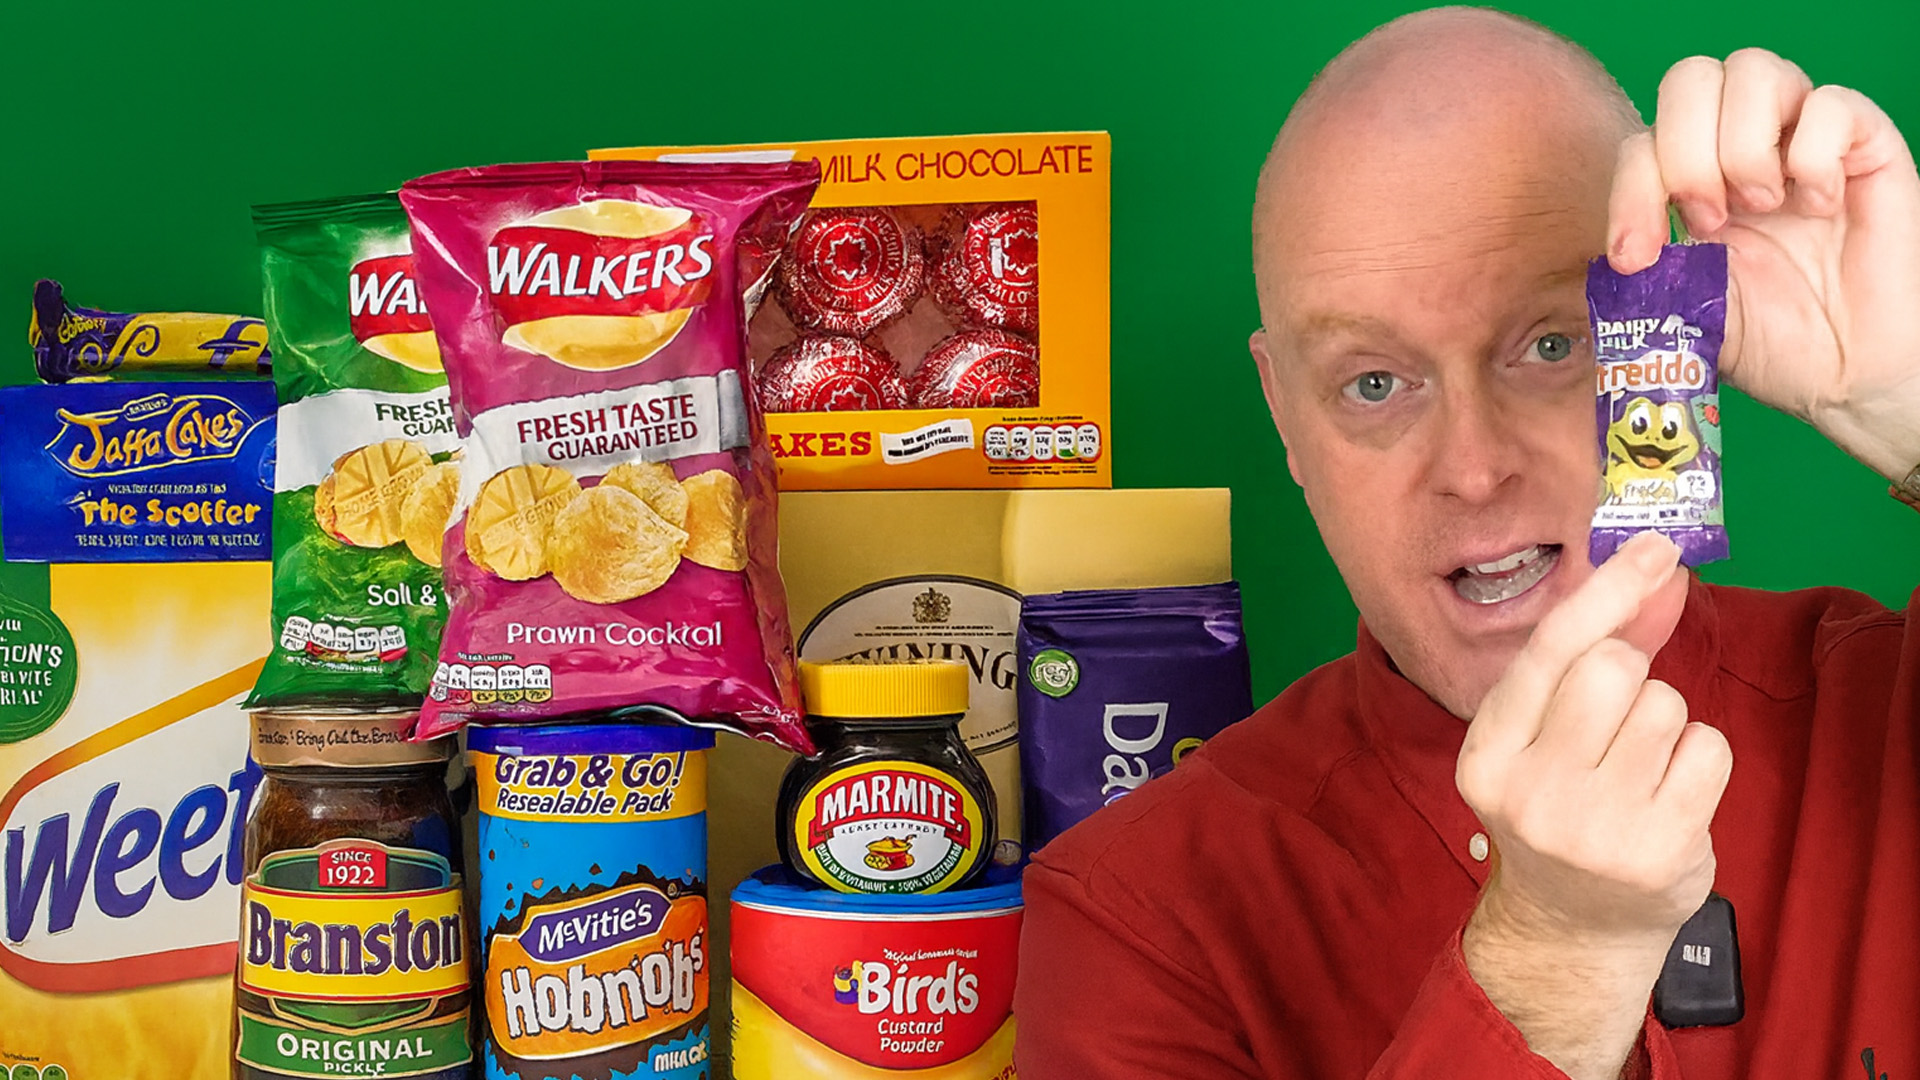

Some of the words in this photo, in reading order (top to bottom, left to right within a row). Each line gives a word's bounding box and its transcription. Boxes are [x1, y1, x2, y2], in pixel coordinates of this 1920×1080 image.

[822, 153, 887, 183] MILK
[896, 145, 1093, 181] CHOCOLATE
[486, 235, 714, 300] WALKERS
[350, 271, 428, 317] WA
[57, 407, 161, 470] Jaffa
[165, 400, 244, 457] Cakes
[517, 407, 607, 443] FRESH
[611, 393, 697, 427] TASTE
[547, 420, 699, 461] GUARANTEED
[79, 497, 138, 527] The
[420, 584, 437, 606] &
[507, 622, 596, 645] Prawn
[494, 754, 578, 788] Grab
[579, 755, 615, 789] &
[621, 751, 687, 789] Go!
[496, 787, 618, 816] Resealable
[620, 788, 674, 815] Pack
[331, 851, 372, 864] SINCE
[326, 865, 375, 885] 1922
[247, 900, 463, 976] Branston
[537, 898, 653, 954] McVitie's
[858, 960, 980, 1015] Bird's
[877, 1017, 943, 1035] Custard
[276, 1032, 433, 1063] ORIGINAL
[880, 1037, 944, 1053] Powder
[324, 1061, 387, 1077] PICKLE
